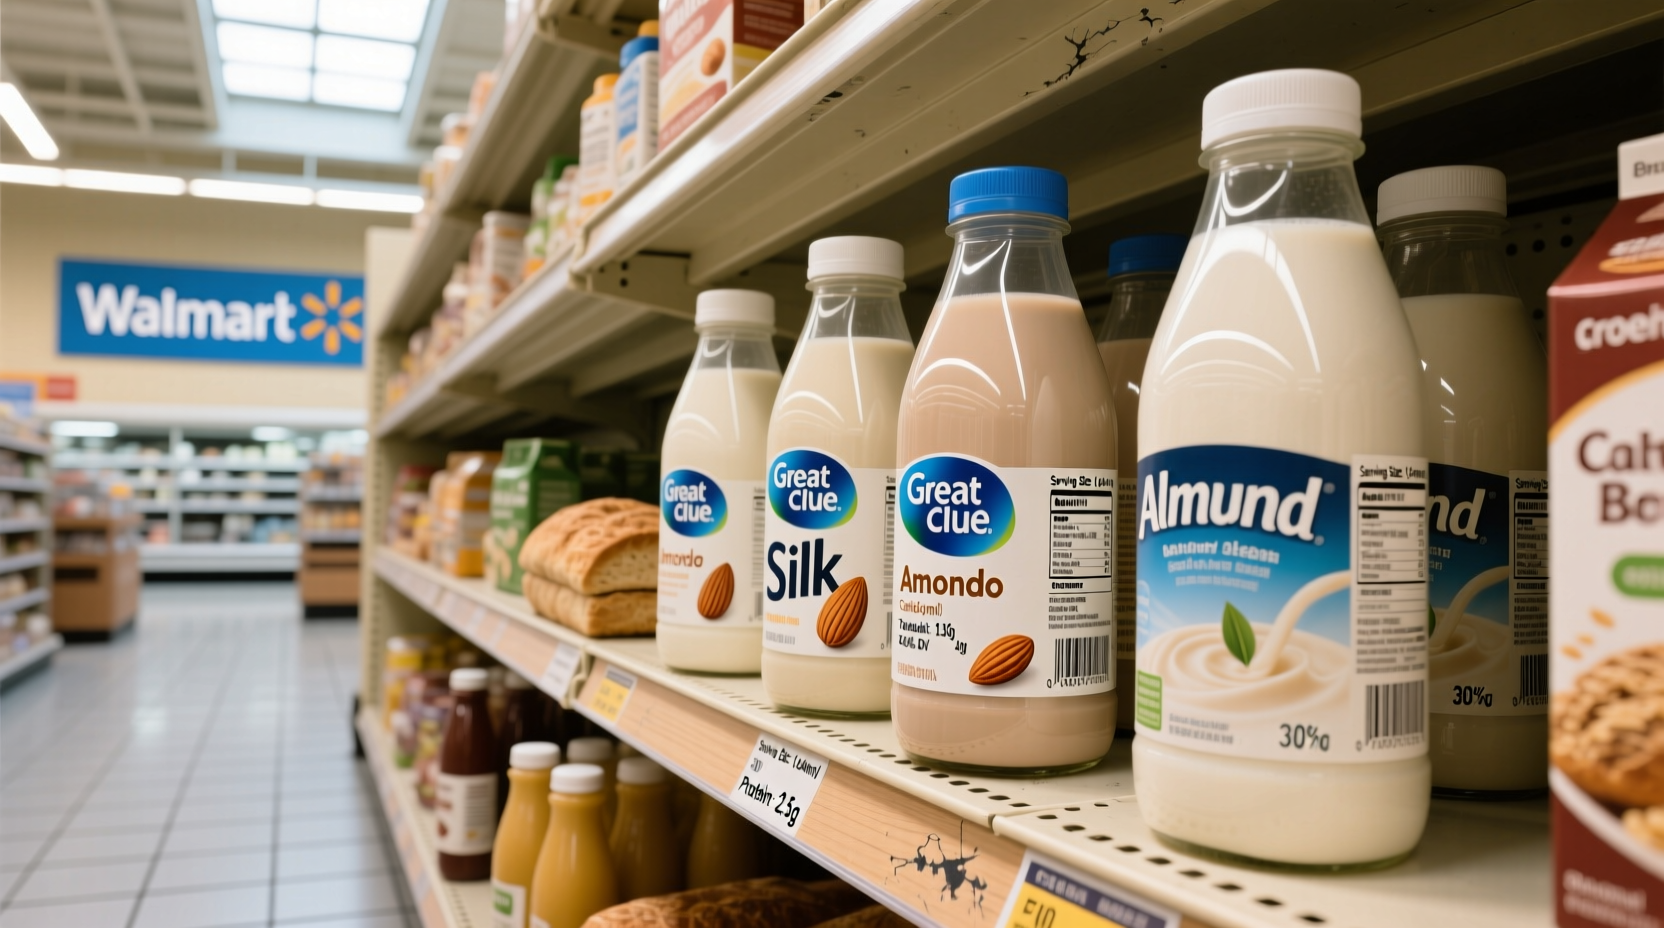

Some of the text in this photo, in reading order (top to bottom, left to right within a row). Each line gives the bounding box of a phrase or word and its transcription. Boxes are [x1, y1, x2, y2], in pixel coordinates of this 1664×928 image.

[76, 281, 297, 344] Walmart
[663, 478, 707, 503] Great
[773, 462, 831, 489] Great
[906, 471, 982, 506] Great
[1138, 469, 1323, 542] Almund
[766, 538, 843, 602] Silk
[900, 565, 1004, 599] Amondo
